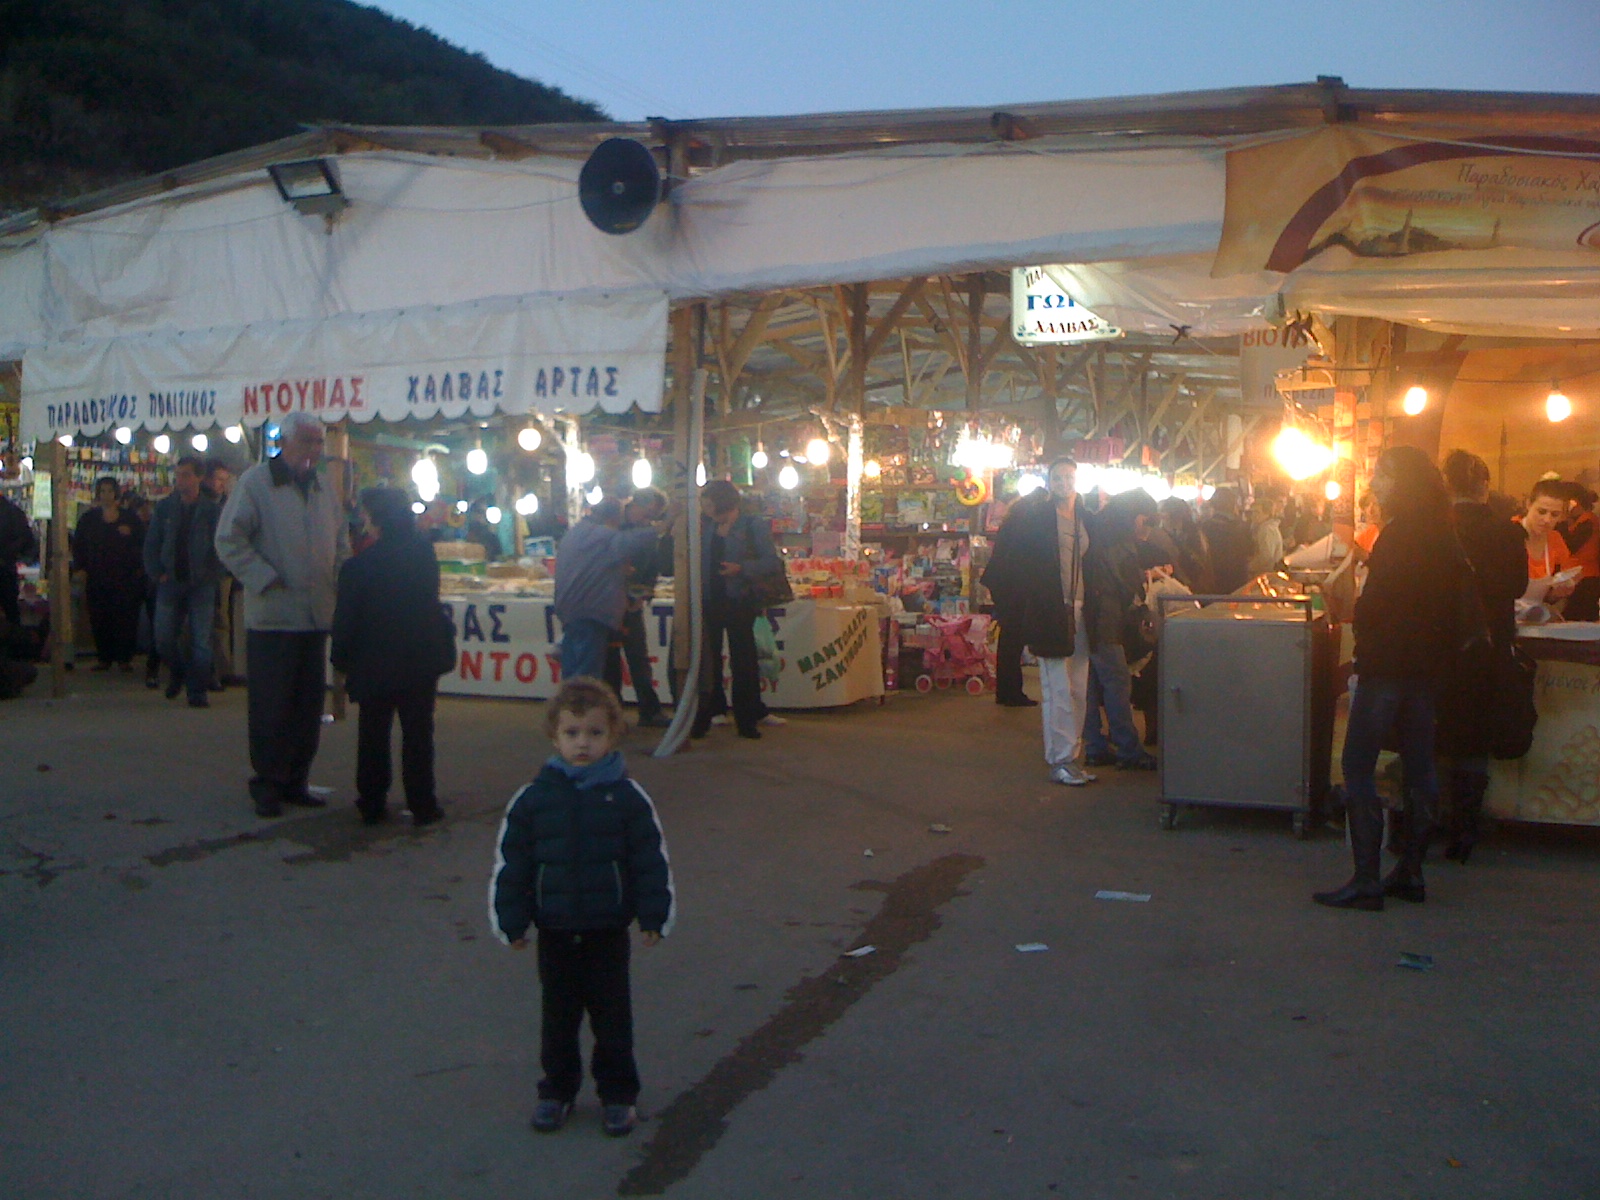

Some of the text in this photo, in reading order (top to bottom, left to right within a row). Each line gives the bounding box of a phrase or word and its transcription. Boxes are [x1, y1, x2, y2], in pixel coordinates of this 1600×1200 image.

[1576, 170, 1600, 194] Χα
[407, 370, 503, 404] ΧΑΛΒΑΣ
[536, 366, 619, 398] ΑΡΤΑΣ
